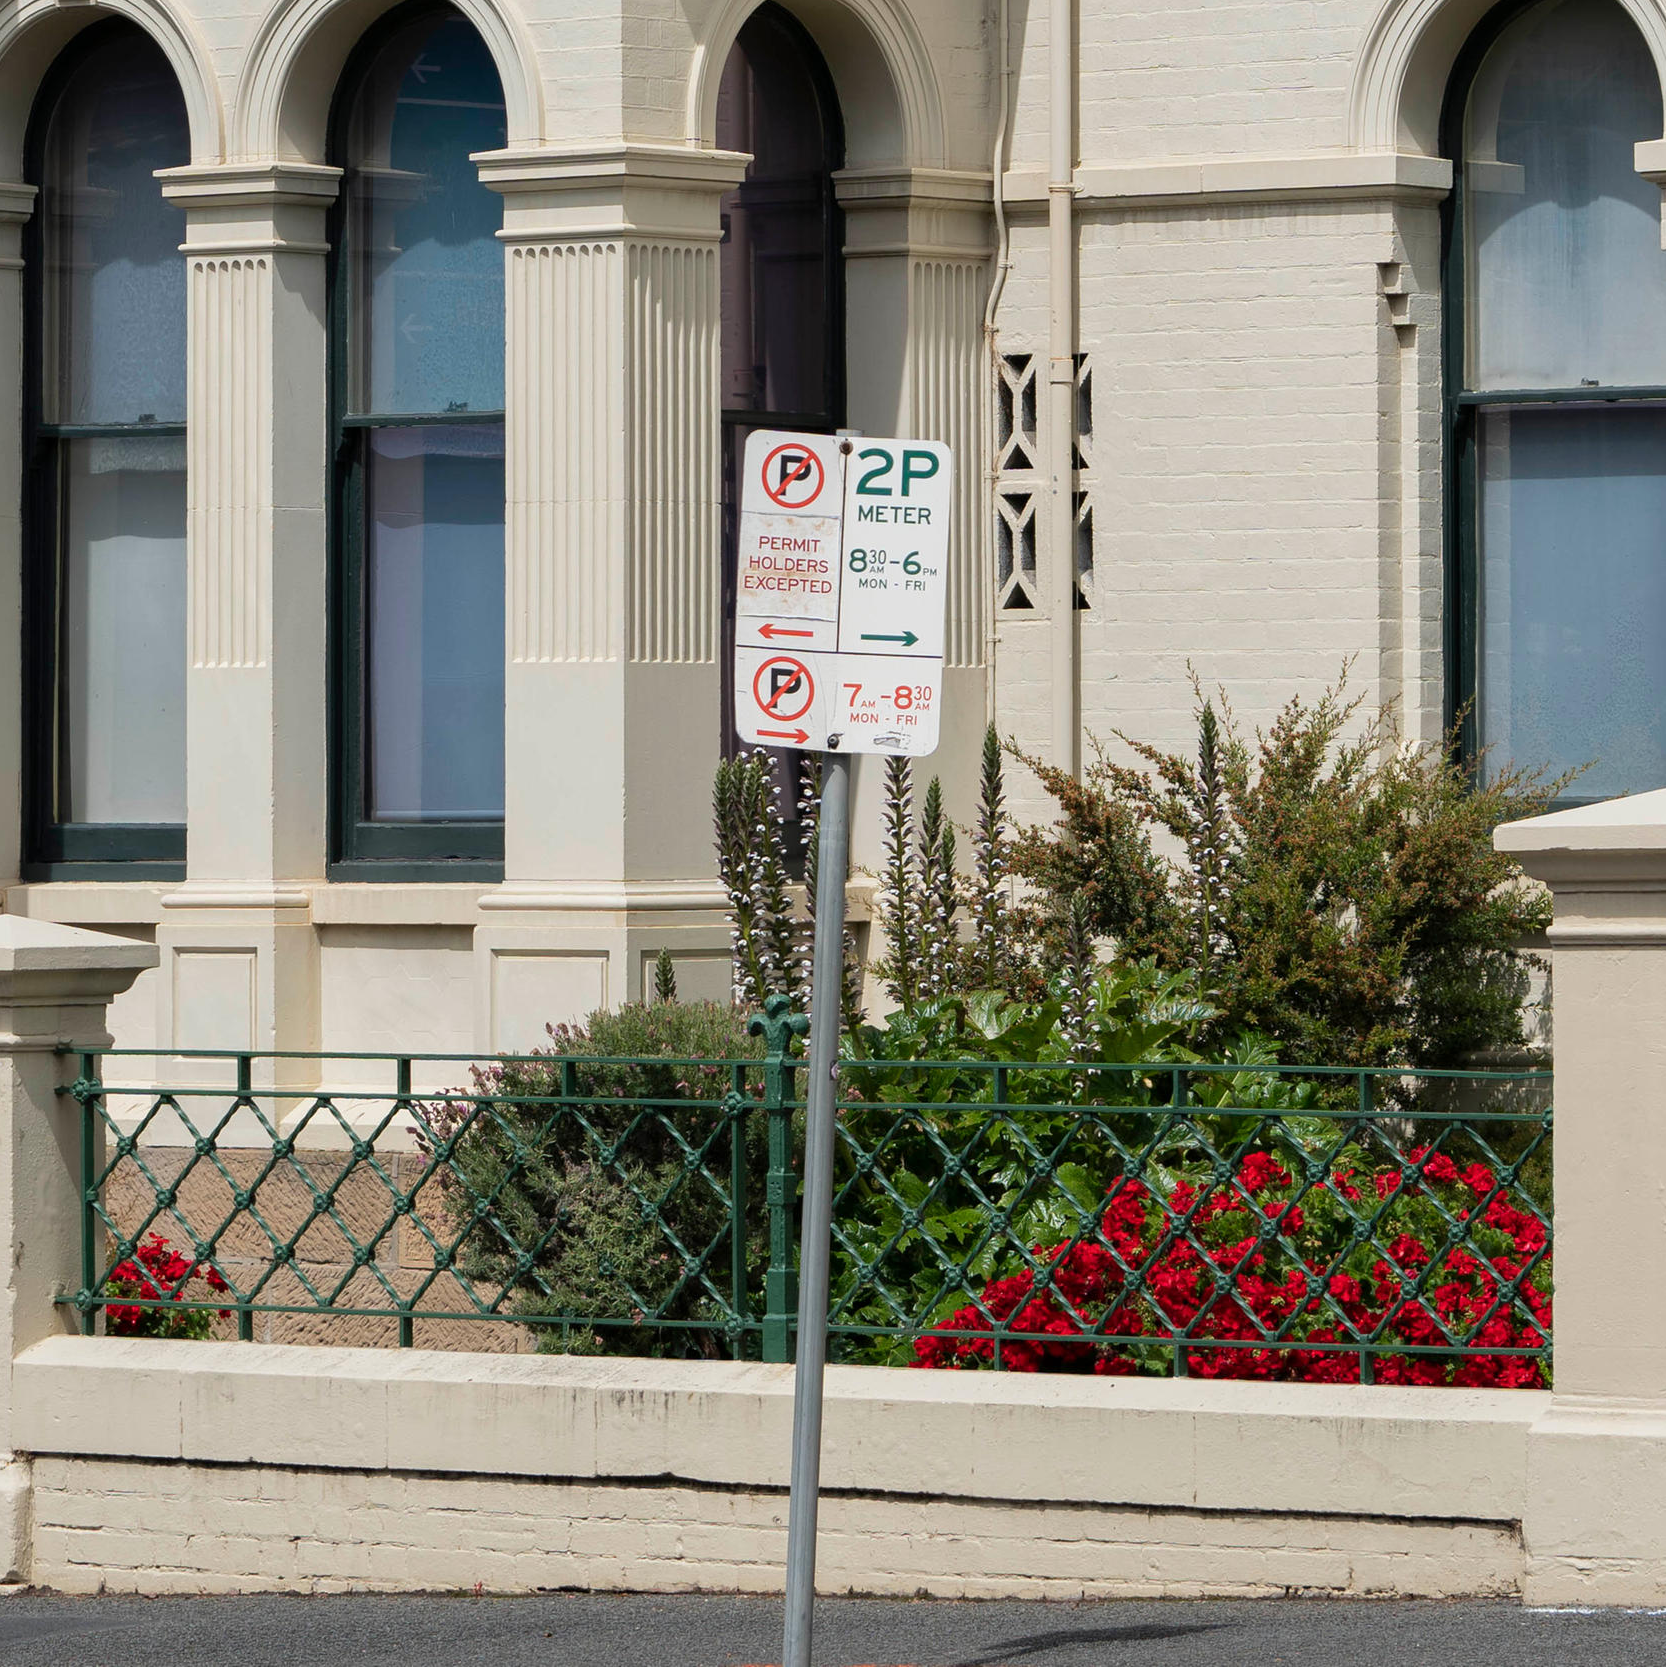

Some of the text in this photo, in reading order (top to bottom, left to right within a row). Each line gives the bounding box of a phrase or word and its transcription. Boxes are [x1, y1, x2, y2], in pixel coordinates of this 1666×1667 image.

[856, 449, 939, 496] 2P
[859, 505, 931, 524] METER
[759, 536, 820, 552] PERMIT
[750, 556, 829, 574] HOLDERS
[744, 575, 832, 594] EXCEPTED
[858, 578, 888, 589] MON
[905, 580, 926, 590] FRI
[849, 713, 879, 723] MON
[896, 715, 918, 725] FRI
